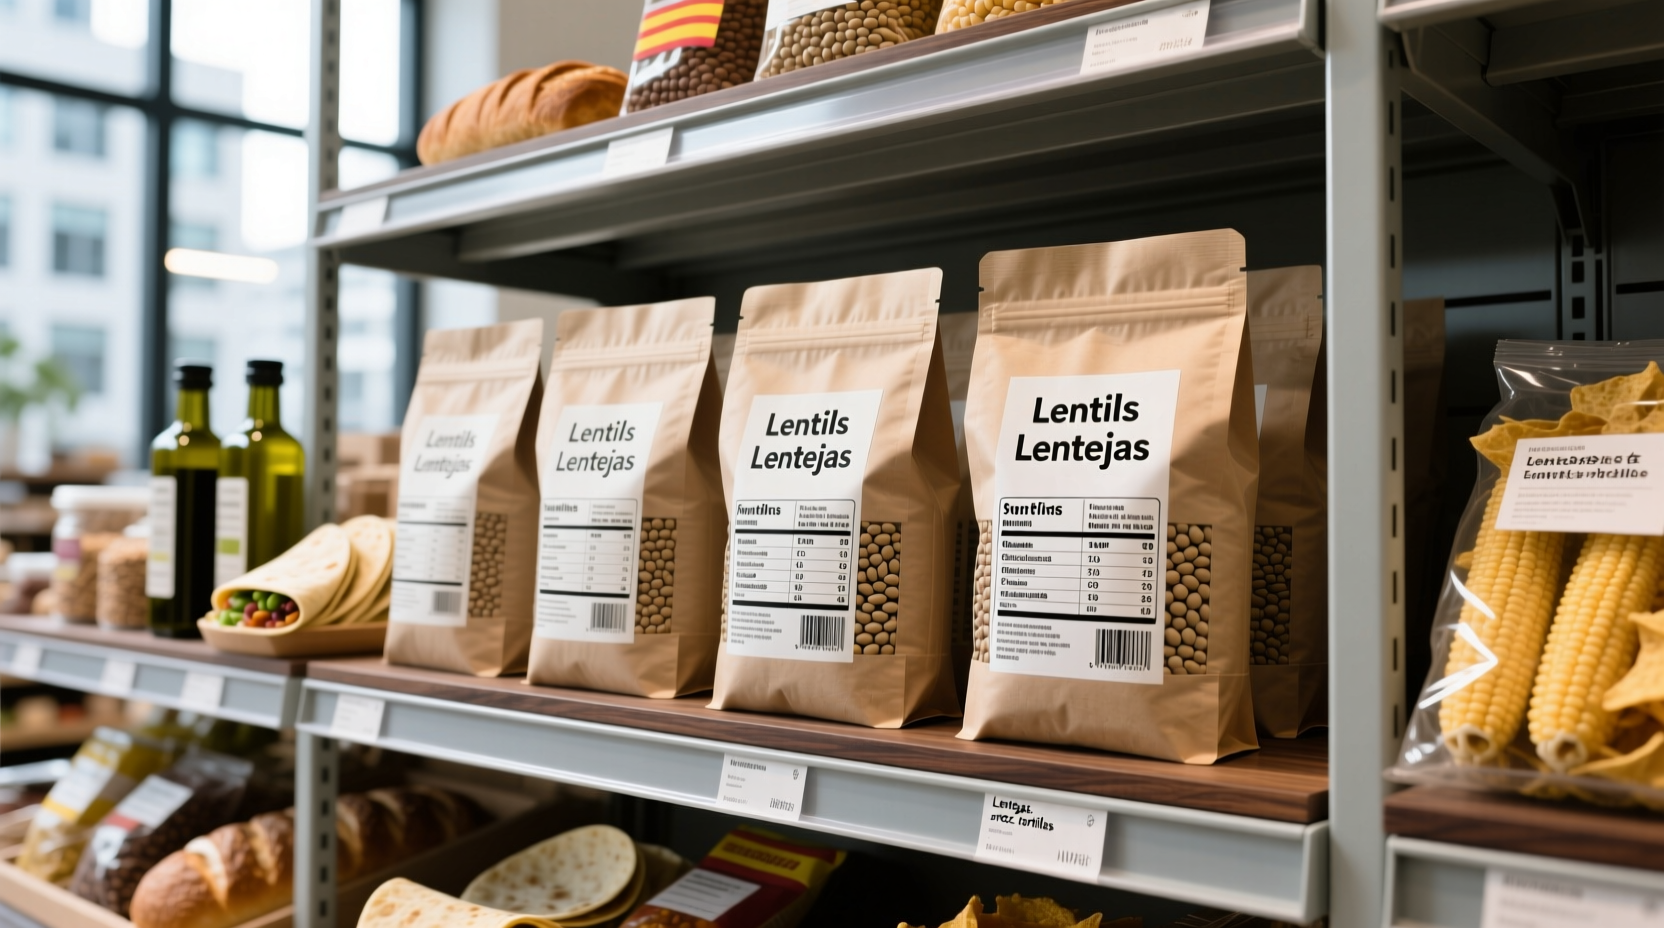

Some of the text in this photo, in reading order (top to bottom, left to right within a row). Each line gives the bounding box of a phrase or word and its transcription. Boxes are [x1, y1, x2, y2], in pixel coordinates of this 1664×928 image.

[766, 409, 849, 436] Lentils
[1033, 393, 1139, 423] Lentils
[568, 420, 635, 442] Lentils
[556, 449, 635, 478] Lentejas
[750, 443, 852, 476] Lentejas
[1015, 431, 1149, 470] Lentejas
